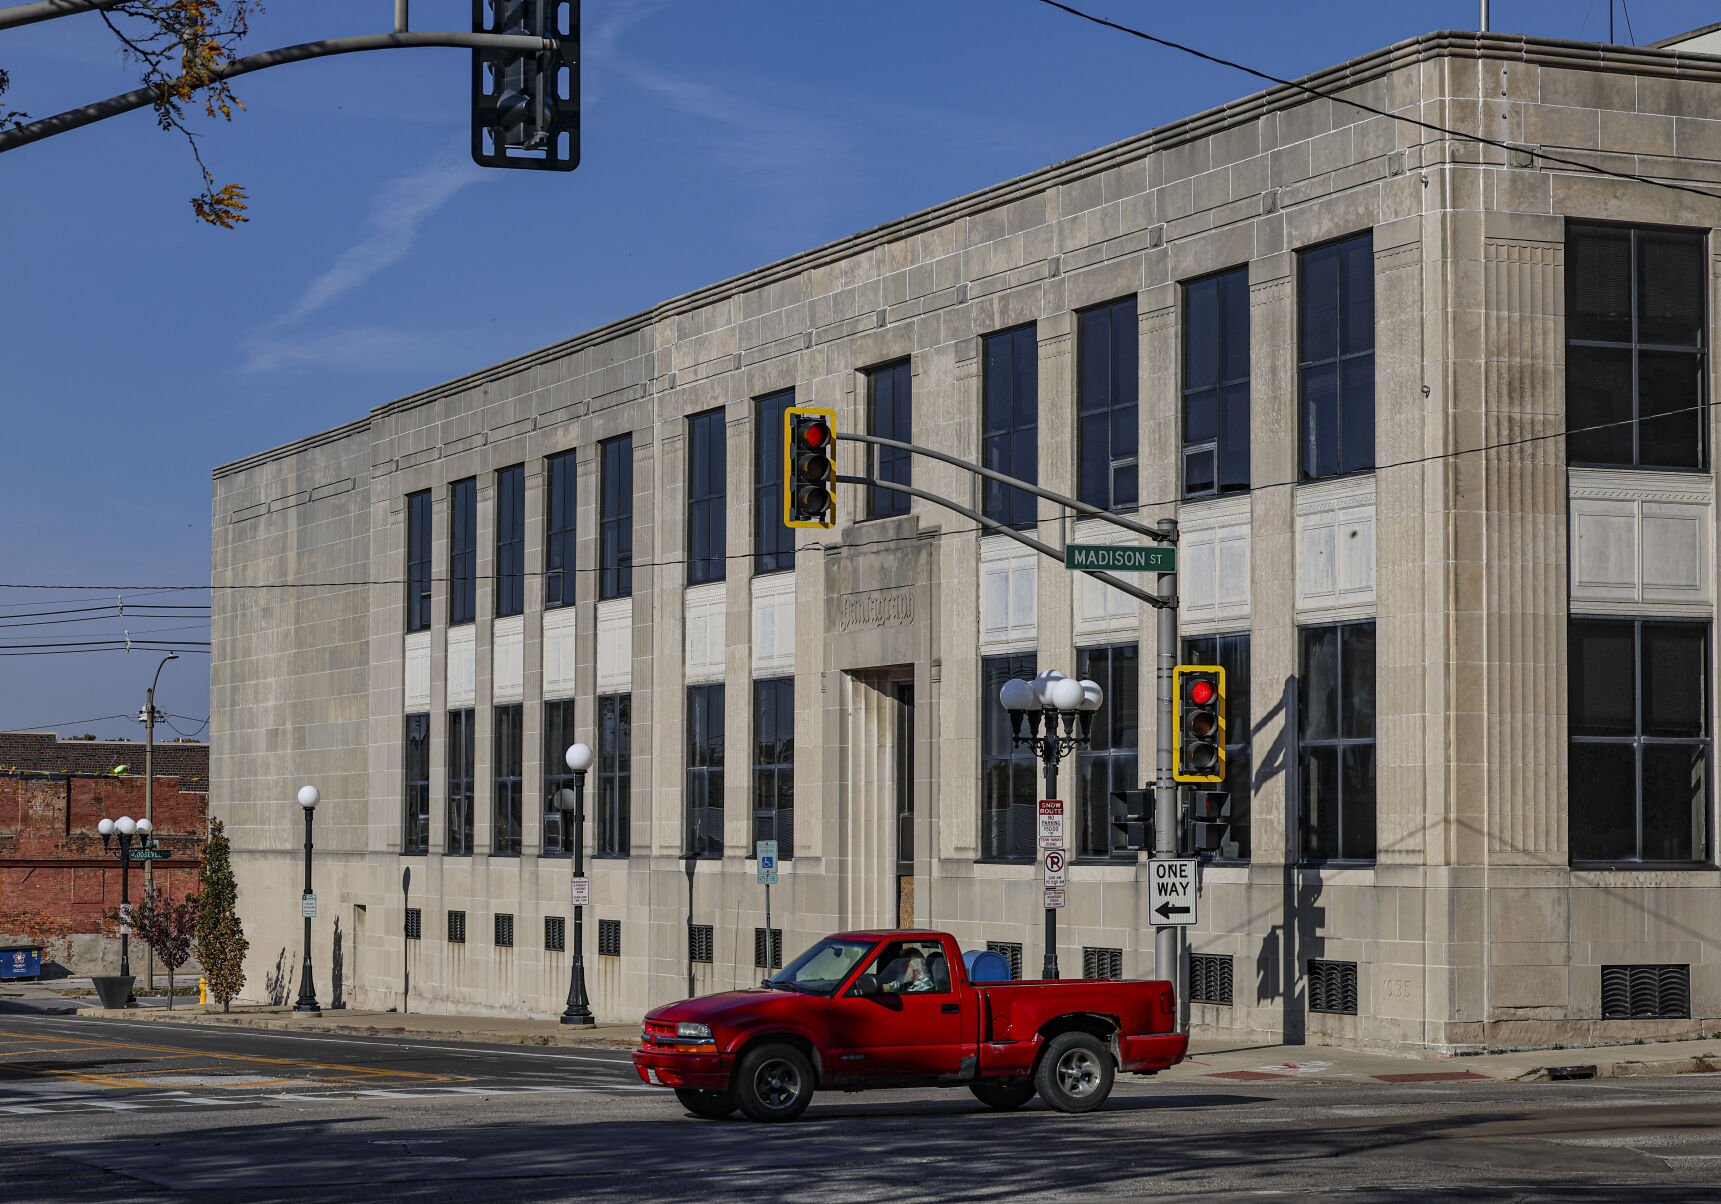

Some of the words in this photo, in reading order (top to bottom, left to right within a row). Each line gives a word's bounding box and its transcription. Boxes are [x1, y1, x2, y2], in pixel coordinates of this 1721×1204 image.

[1074, 549, 1145, 566] MADISON
[1150, 554, 1162, 565] ST
[1156, 864, 1188, 878] ONE
[1157, 882, 1190, 896] WAY
